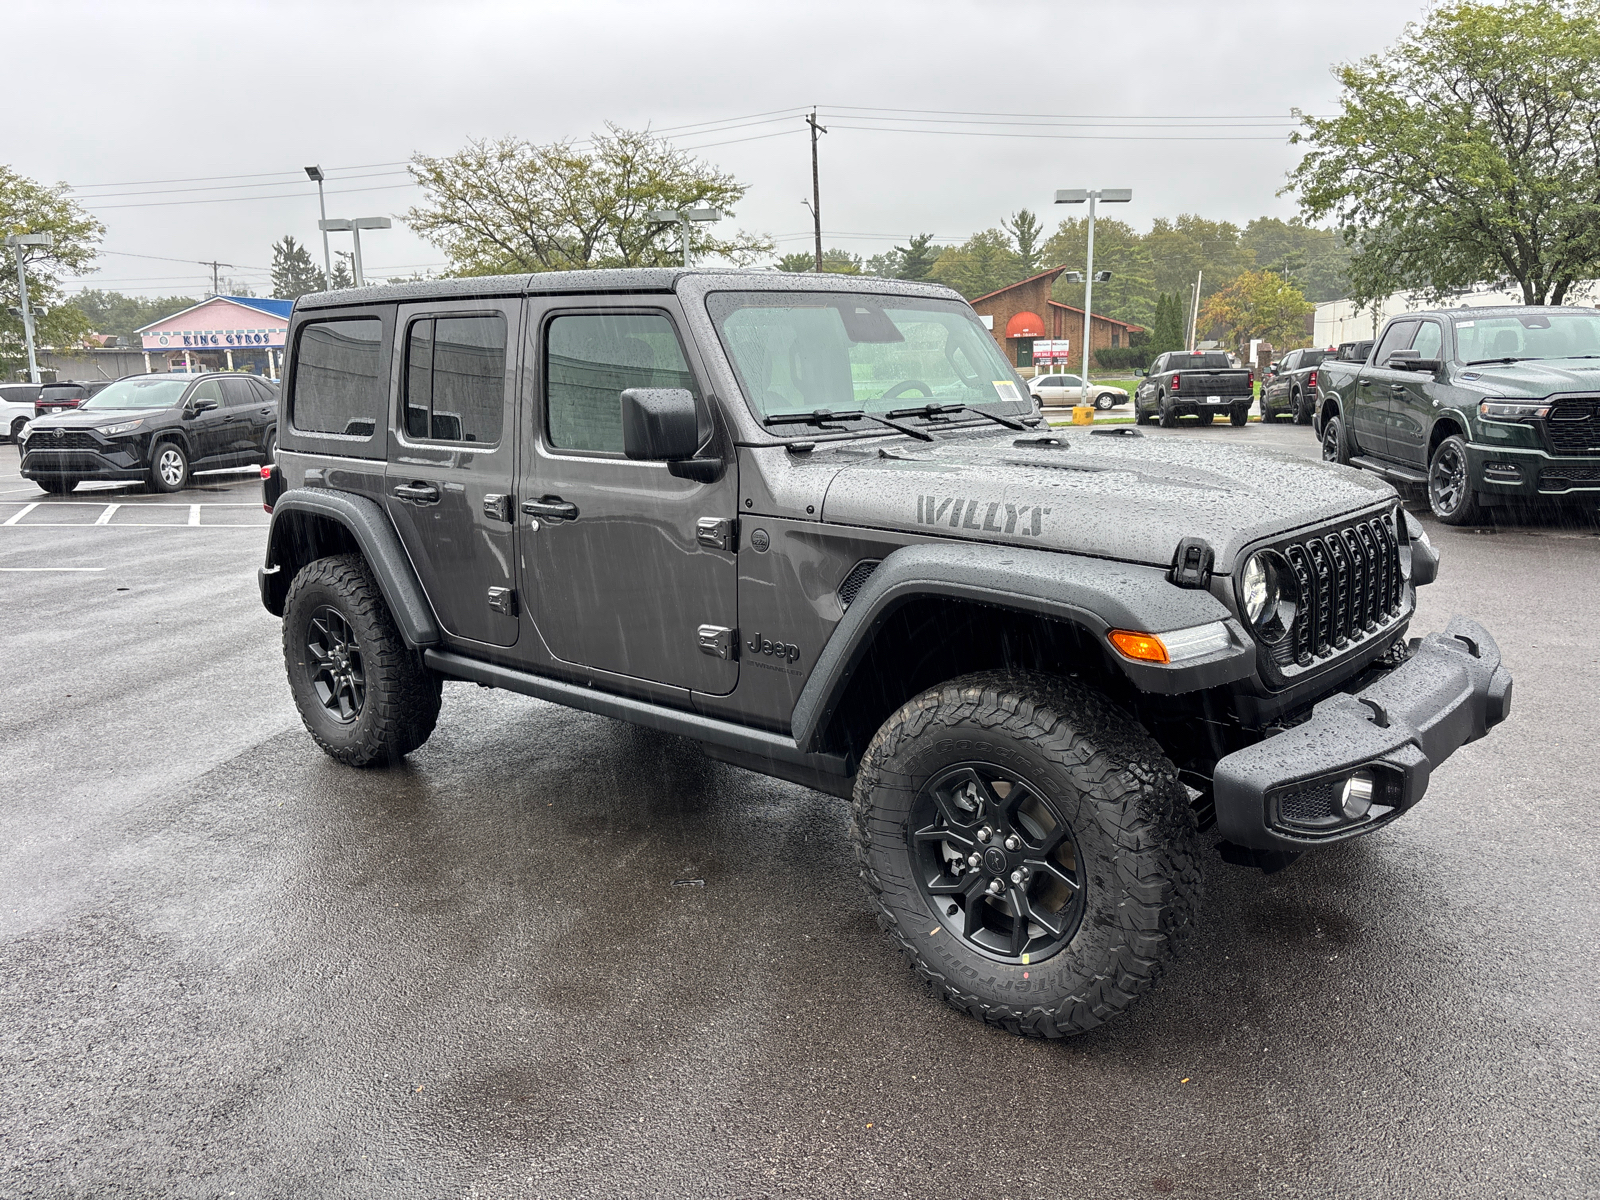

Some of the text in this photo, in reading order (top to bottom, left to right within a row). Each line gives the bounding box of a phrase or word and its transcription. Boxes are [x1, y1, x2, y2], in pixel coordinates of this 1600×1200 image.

[183, 333, 269, 346] KING GYROS
[917, 495, 1052, 536] WILLYS
[747, 632, 800, 664] Jeep
[754, 661, 803, 677] WRANGLER
